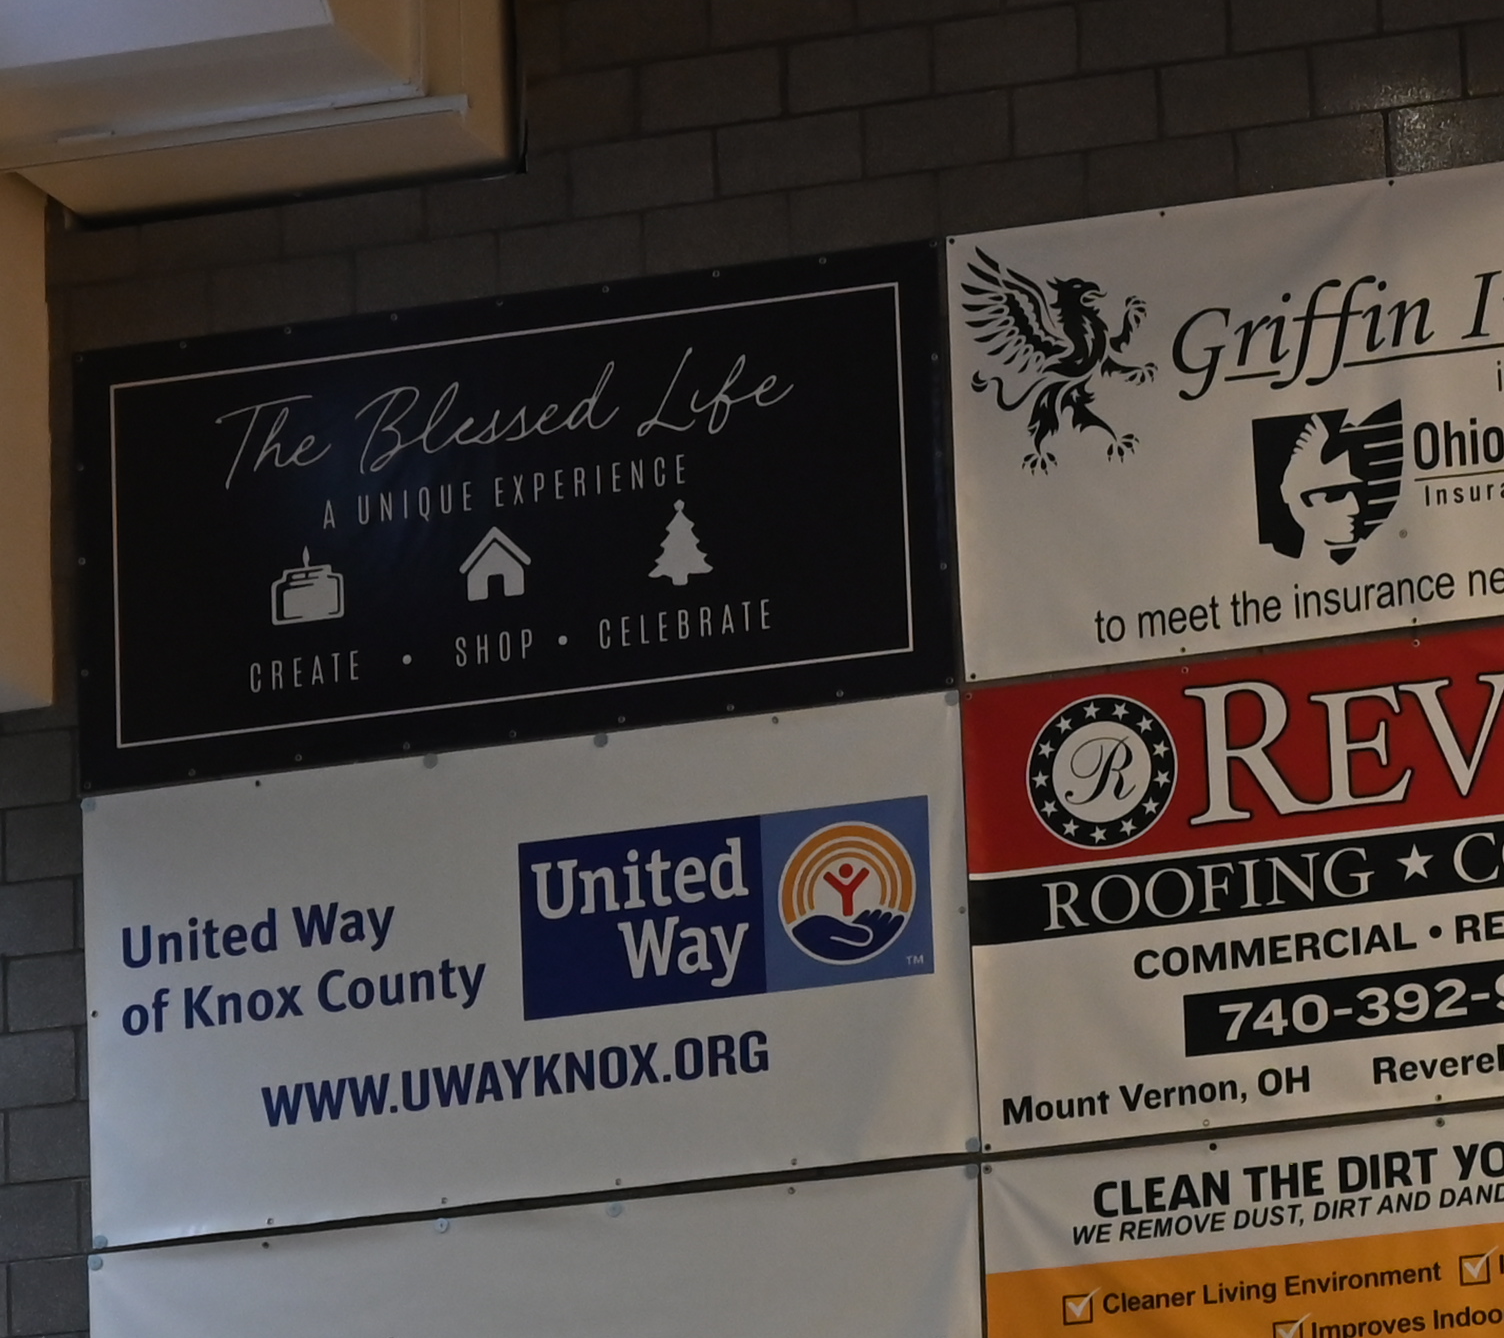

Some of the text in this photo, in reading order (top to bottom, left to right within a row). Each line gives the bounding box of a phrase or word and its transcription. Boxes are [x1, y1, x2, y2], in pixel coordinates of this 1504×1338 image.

[1170, 272, 1435, 401] Griffin
[215, 345, 795, 491] The Blessed Life
[322, 453, 688, 530] A UNIQUE EXPERIENCE
[248, 598, 774, 693] CREATE SHOP CELEBRATE
[1095, 610, 1127, 646] to
[1138, 601, 1222, 639] meet
[1229, 590, 1283, 630] the
[1292, 571, 1457, 623] insurance
[1063, 734, 1141, 809] R
[530, 837, 750, 922] United
[1043, 844, 1374, 933] ROOFING
[120, 901, 396, 970] United Way
[616, 918, 751, 988] Way
[1133, 919, 1417, 981] COMMERCIAL
[120, 958, 487, 1037] of Knox County
[261, 1029, 771, 1128] WWW.UWAYKNOX.ORG
[1001, 1064, 1312, 1127] Mount Vernon, OH
[1071, 1222, 1113, 1249] WE
[1119, 1208, 1227, 1243] REMOVE
[1232, 1202, 1307, 1234] DUST,
[1312, 1194, 1374, 1225] DIRT
[1377, 1187, 1433, 1217] AND
[1093, 1169, 1232, 1219] CLEAN
[1243, 1160, 1325, 1204] THE
[1338, 1146, 1439, 1194] DIRT
[1102, 1286, 1196, 1317] Cleaner
[1202, 1278, 1279, 1310] Living
[1283, 1259, 1443, 1299] Environment
